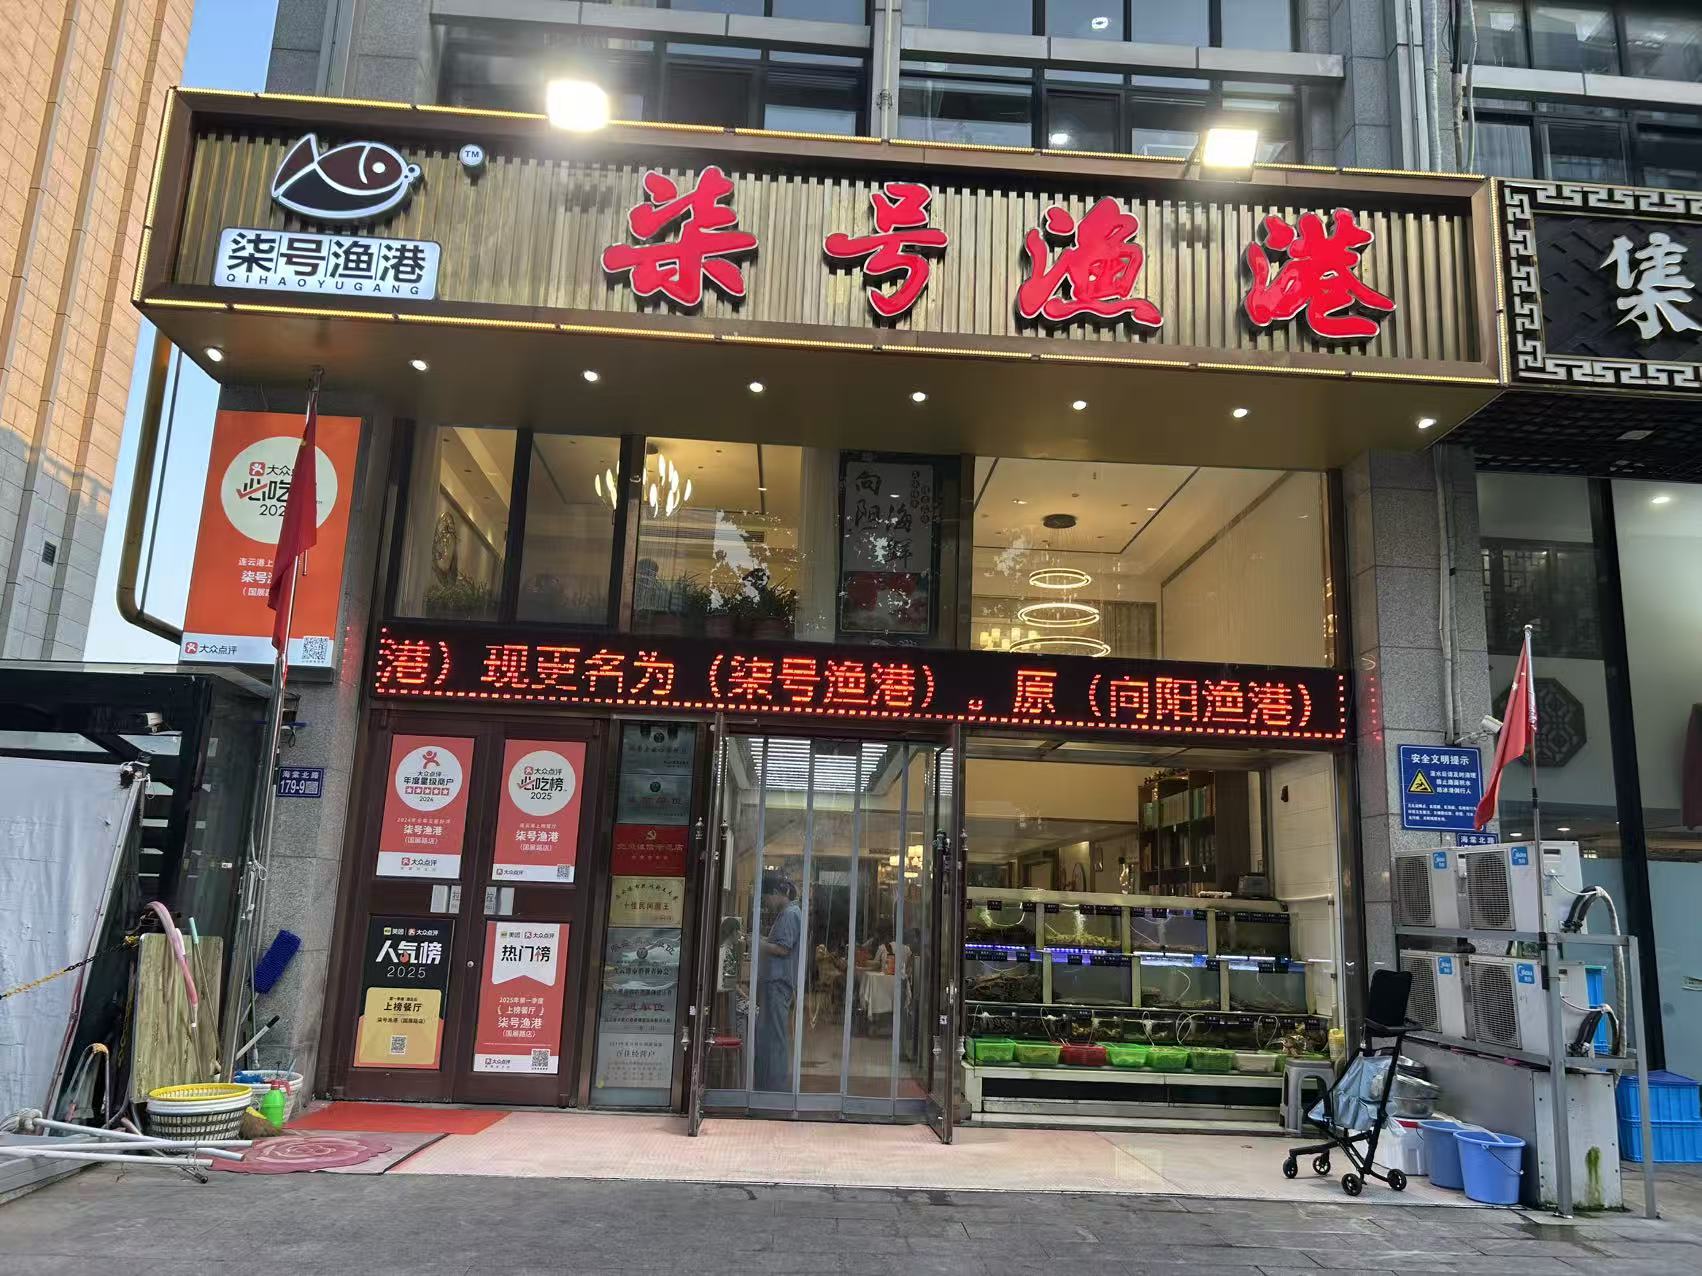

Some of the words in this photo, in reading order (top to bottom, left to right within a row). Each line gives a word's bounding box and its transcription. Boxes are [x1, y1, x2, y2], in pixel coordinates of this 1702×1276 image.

[465, 150, 480, 158] TM
[226, 232, 426, 284] 柒号渔港
[601, 165, 1398, 339] 柒号渔港
[226, 273, 420, 296] QIHAOYUGANG
[266, 464, 295, 477] 大众
[236, 477, 291, 502] 必吃
[259, 503, 288, 517] 202
[238, 557, 274, 568] 连云港上
[198, 643, 238, 655] 大众点评
[1411, 753, 1470, 766] 安全文明提示
[533, 767, 562, 777] 大众点评
[280, 780, 305, 793] 179-9
[403, 776, 454, 787] 年度星级商户
[518, 776, 564, 792] 必吃榜
[530, 791, 552, 801] 2025
[403, 824, 443, 836] 柒号渔港
[515, 830, 559, 842] 柒号渔港
[410, 858, 437, 867] 大众点评
[375, 940, 442, 965] 人气榜
[500, 944, 551, 963] 热门榜
[387, 965, 426, 979] 2025
[383, 1002, 423, 1013] 上榜餐厅
[505, 1005, 537, 1015] 上榜餐厅
[498, 1017, 542, 1029] 柒号渔港
